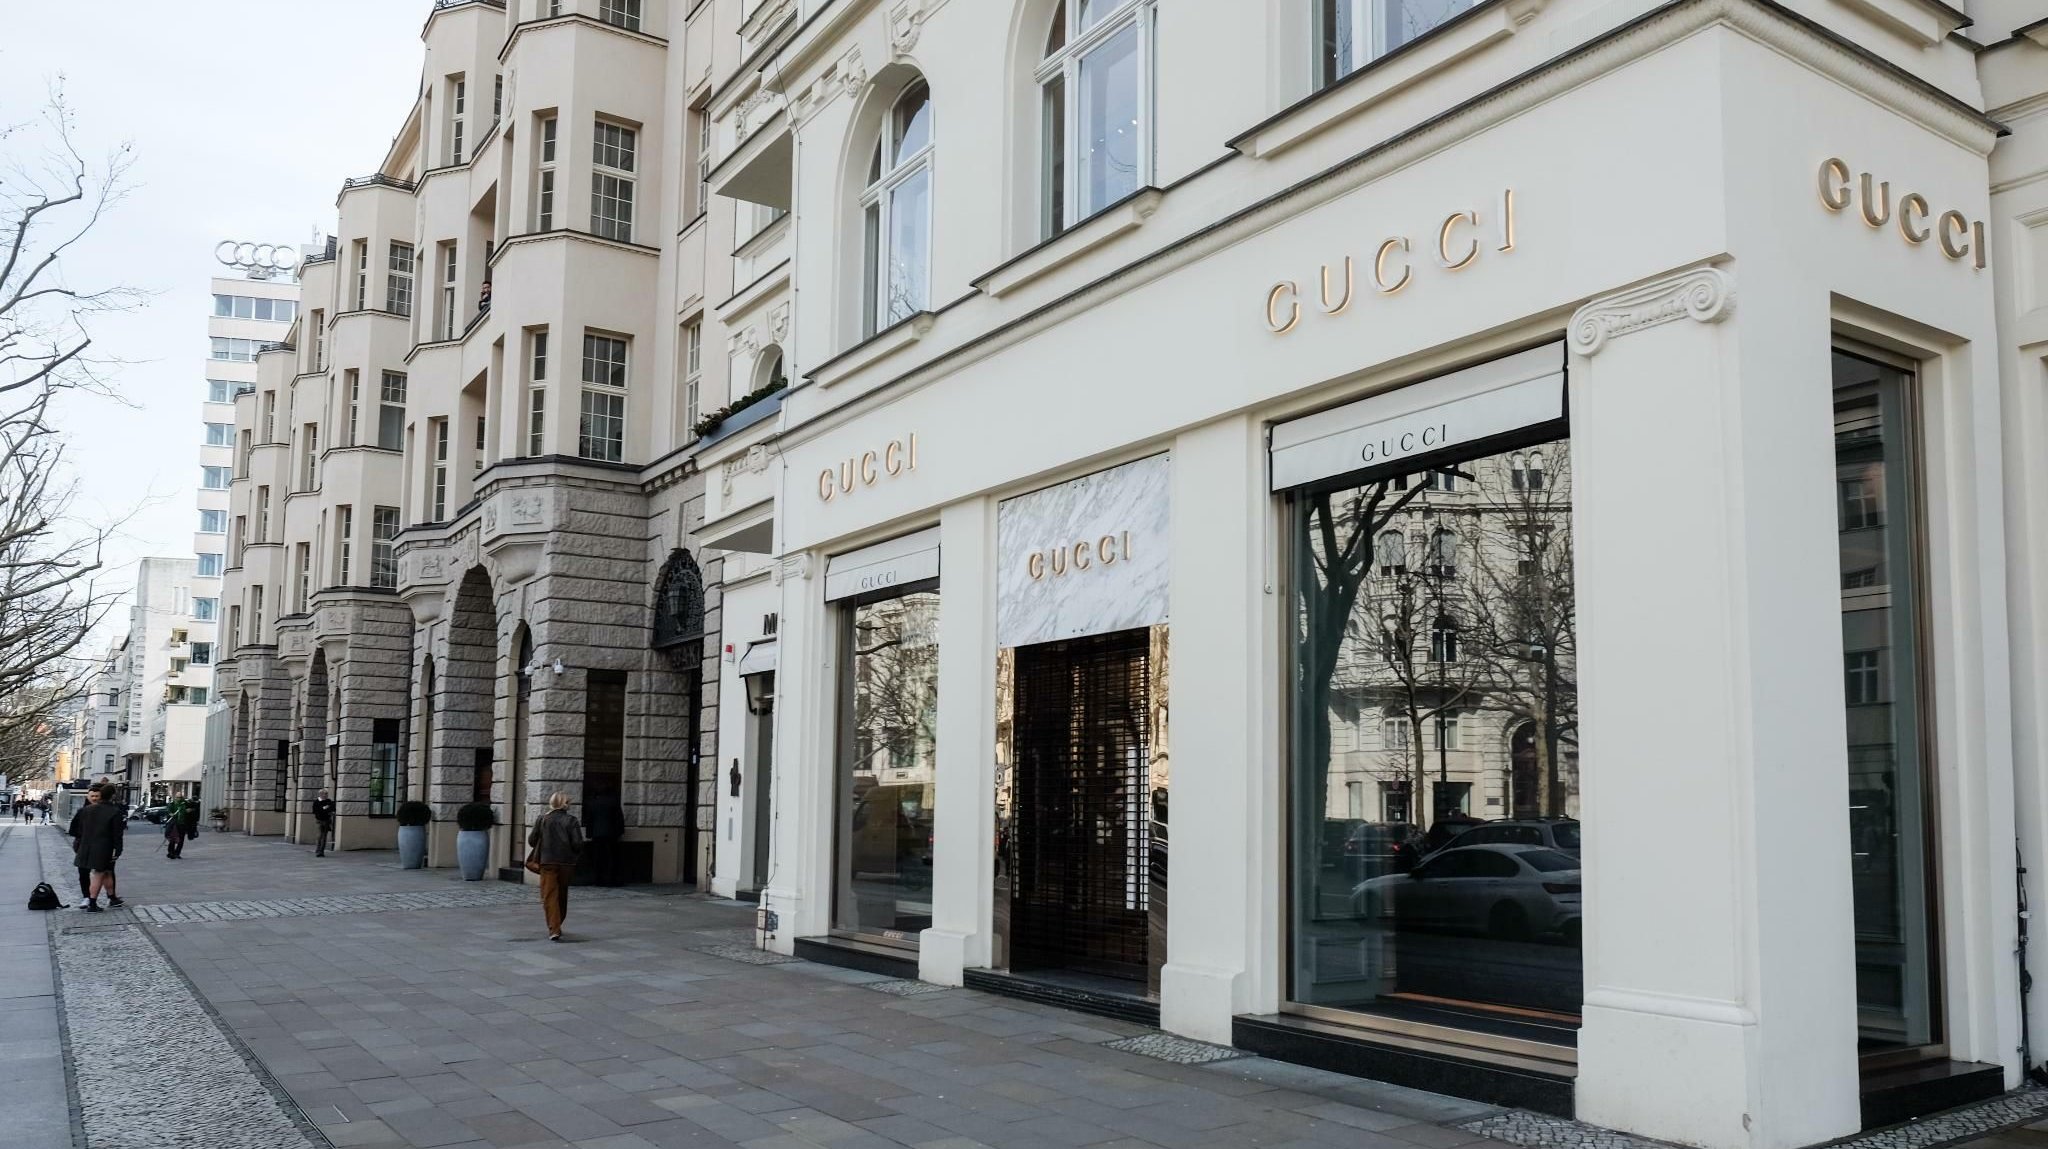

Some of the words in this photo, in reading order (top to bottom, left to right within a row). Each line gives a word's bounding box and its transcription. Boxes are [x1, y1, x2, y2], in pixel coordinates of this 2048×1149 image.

[1817, 156, 1987, 270] GUCCI
[1264, 187, 1515, 333] GUCCI
[819, 432, 918, 502] GUCCI
[1362, 424, 1446, 461] GUCCI
[861, 570, 897, 589] GUCCI
[1028, 530, 1131, 580] GUCCI
